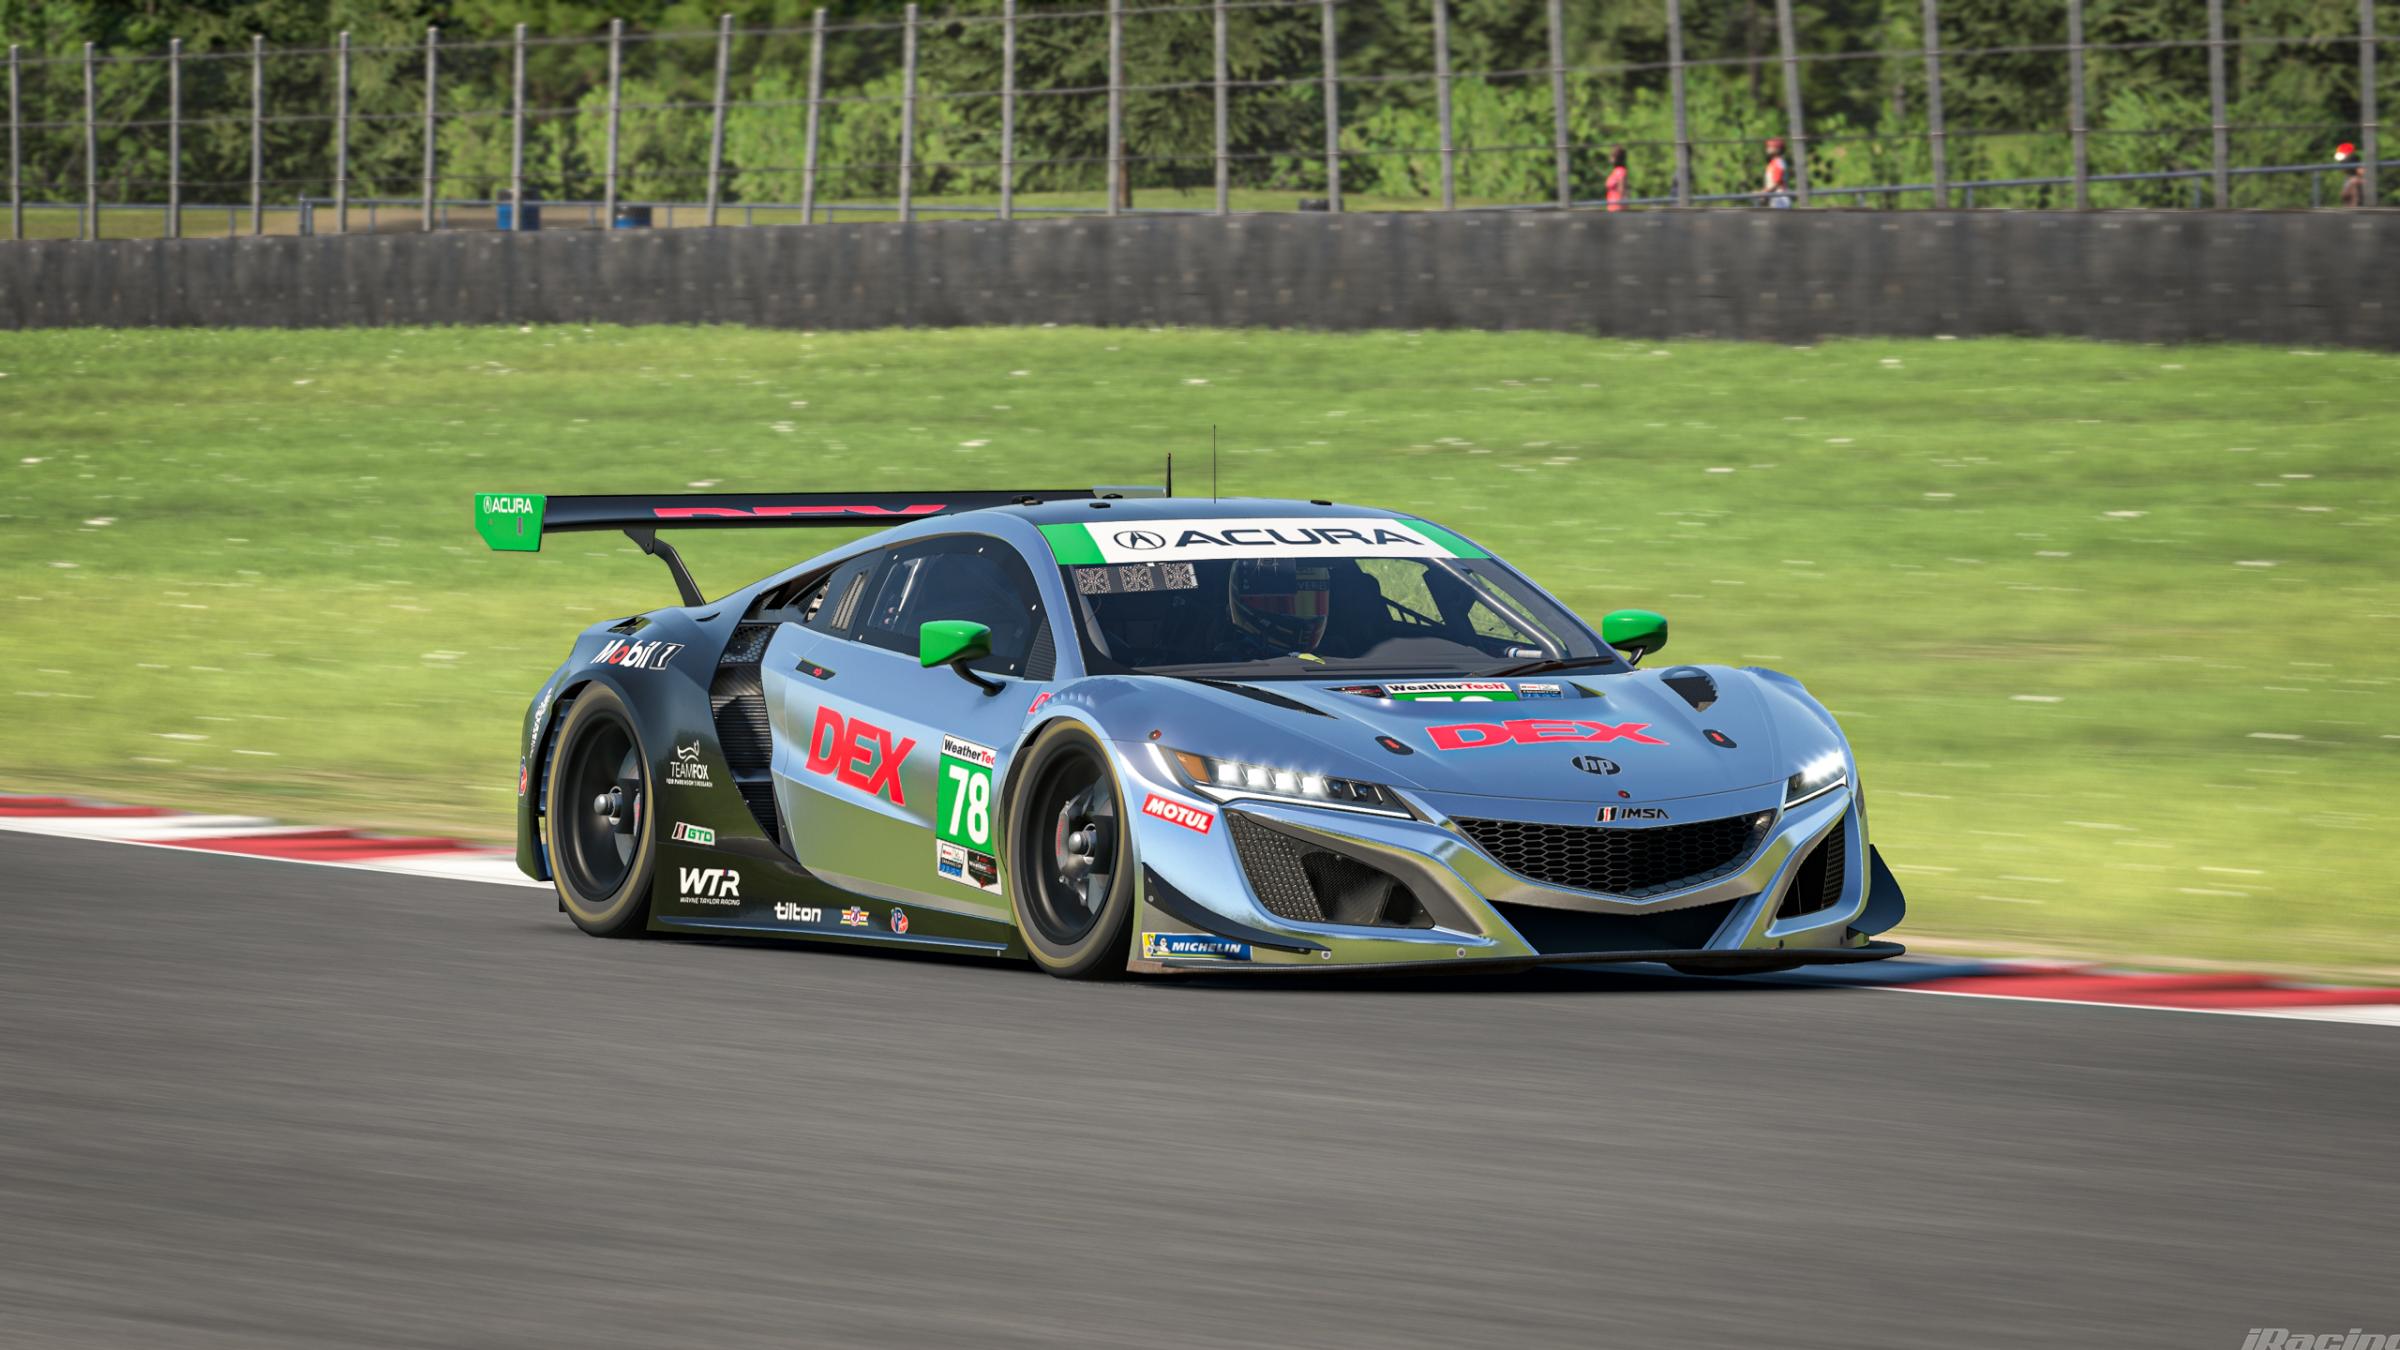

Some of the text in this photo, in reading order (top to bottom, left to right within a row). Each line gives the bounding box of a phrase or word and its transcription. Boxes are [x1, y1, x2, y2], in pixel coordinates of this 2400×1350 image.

[492, 497, 533, 514] ACURA
[1175, 528, 1424, 547] ACURA
[590, 639, 662, 668] Mobil
[1388, 683, 1504, 692] WeatherTech
[1425, 718, 1670, 751] DEX
[805, 705, 917, 806] DEX
[1580, 755, 1613, 775] hp
[949, 764, 990, 845] 78
[1146, 797, 1208, 831] MOTUL
[1621, 808, 1670, 819] IMSA
[687, 828, 713, 842] GTD
[679, 867, 740, 897] WTR
[774, 902, 822, 923] tilton
[1171, 942, 1241, 953] MICHELIN
